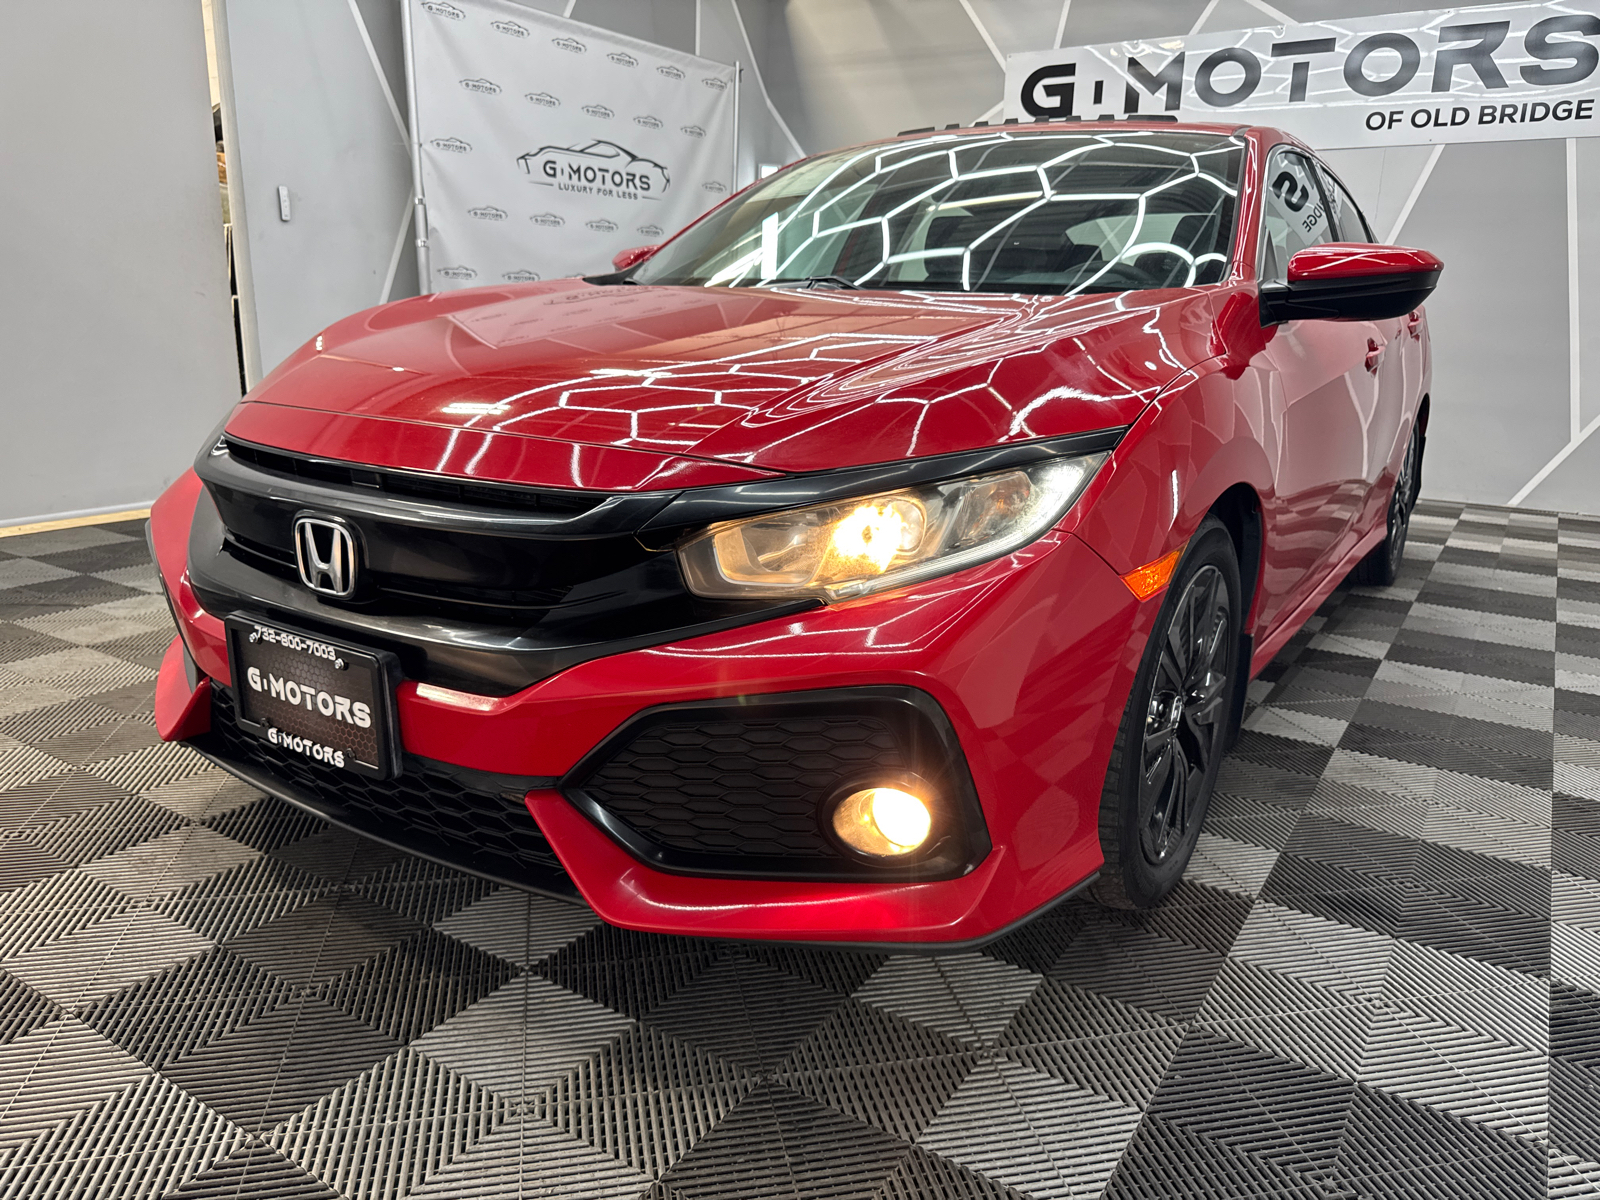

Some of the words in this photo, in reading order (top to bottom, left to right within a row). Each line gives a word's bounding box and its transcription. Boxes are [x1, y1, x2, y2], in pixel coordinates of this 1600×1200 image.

[1365, 110, 1404, 131] OF
[1410, 106, 1470, 129] OLD
[1477, 99, 1595, 126] BRIDGE
[558, 182, 593, 195] LUXURY
[597, 188, 614, 198] FOR
[617, 190, 638, 201] LESS
[254, 625, 337, 661] 732-800-7003
